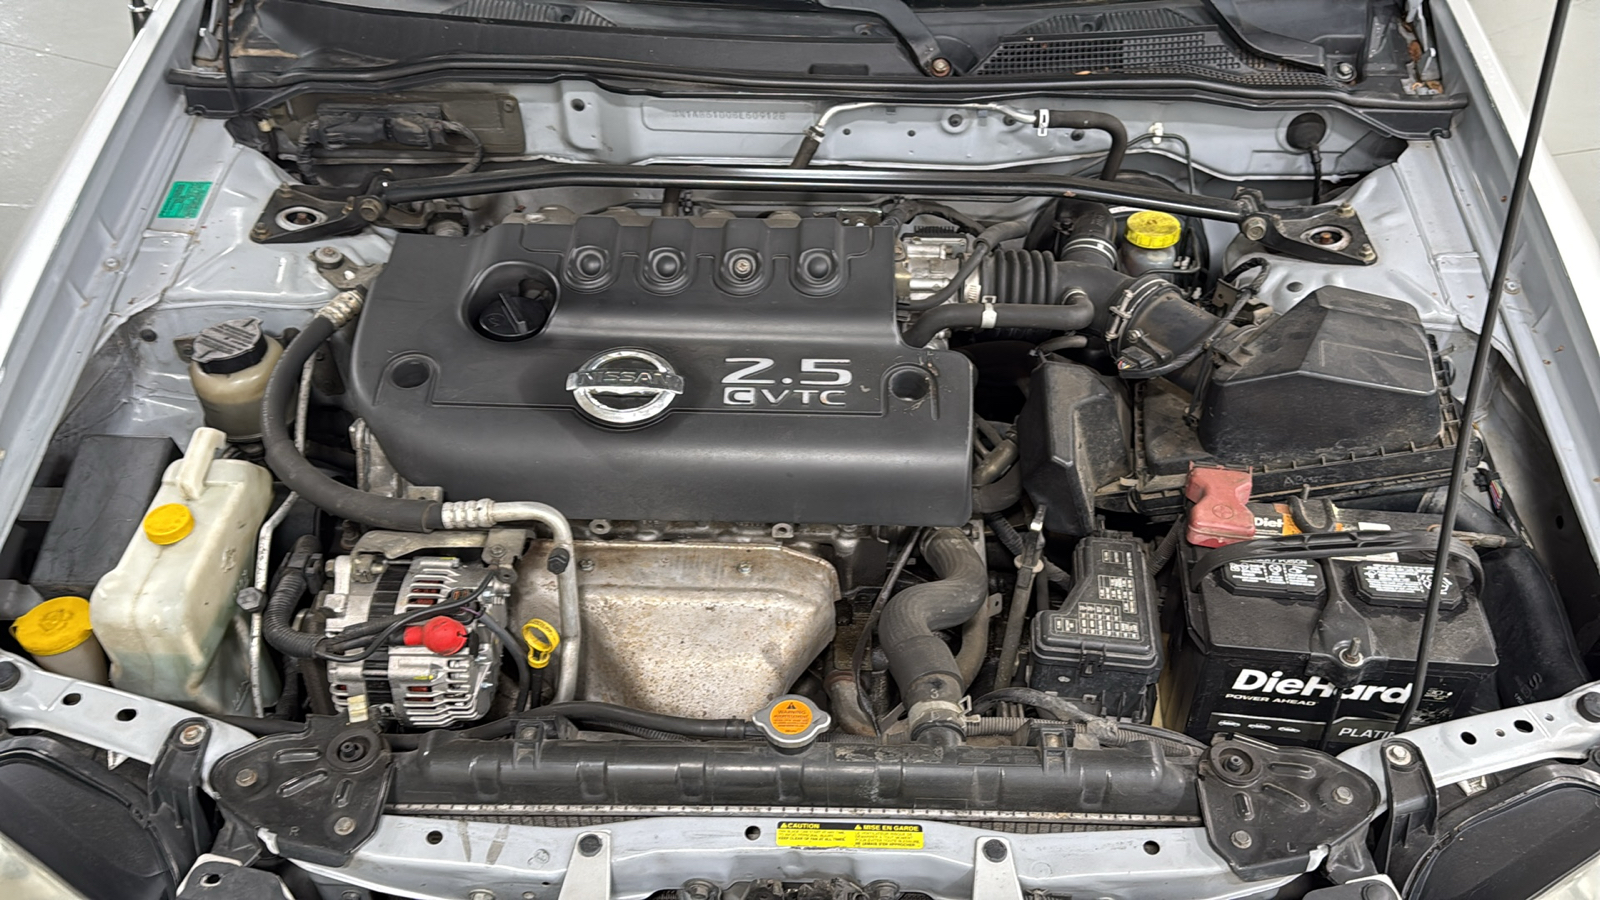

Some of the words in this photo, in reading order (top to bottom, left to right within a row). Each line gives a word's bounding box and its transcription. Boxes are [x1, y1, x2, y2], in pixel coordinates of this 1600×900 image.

[578, 370, 671, 386] NISSAN
[721, 357, 853, 387] 2.5
[1225, 693, 1270, 703] POWER
[1272, 697, 1317, 706] AHEAD
[289, 825, 300, 837] R
[1286, 841, 1298, 853] L
